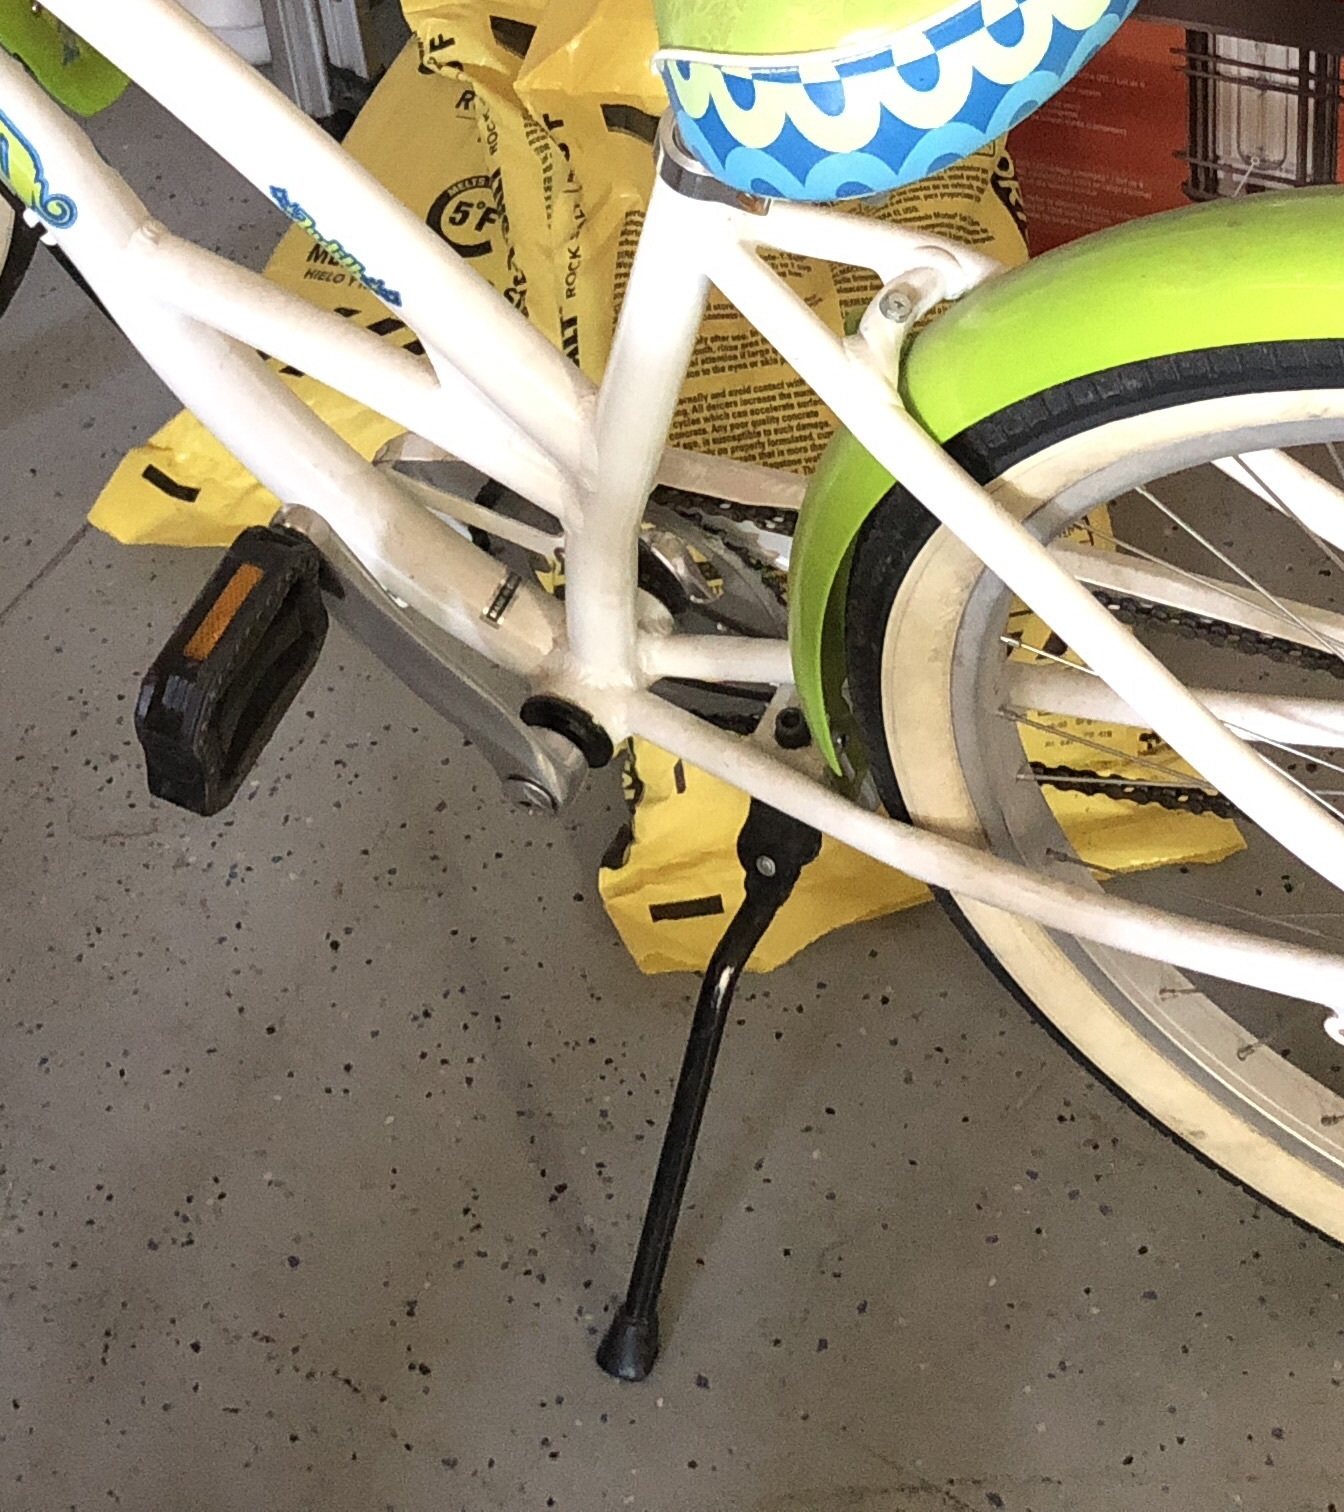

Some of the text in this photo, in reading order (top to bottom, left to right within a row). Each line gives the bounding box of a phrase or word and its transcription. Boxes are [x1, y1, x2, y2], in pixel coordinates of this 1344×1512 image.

[304, 269, 345, 283] HIELO
[565, 246, 581, 299] ROCK
[711, 389, 726, 399] and
[728, 386, 751, 397] avoid
[753, 381, 784, 393] contact
[703, 412, 729, 423] which
[712, 424, 727, 433] Any
[782, 410, 819, 422] concrete
